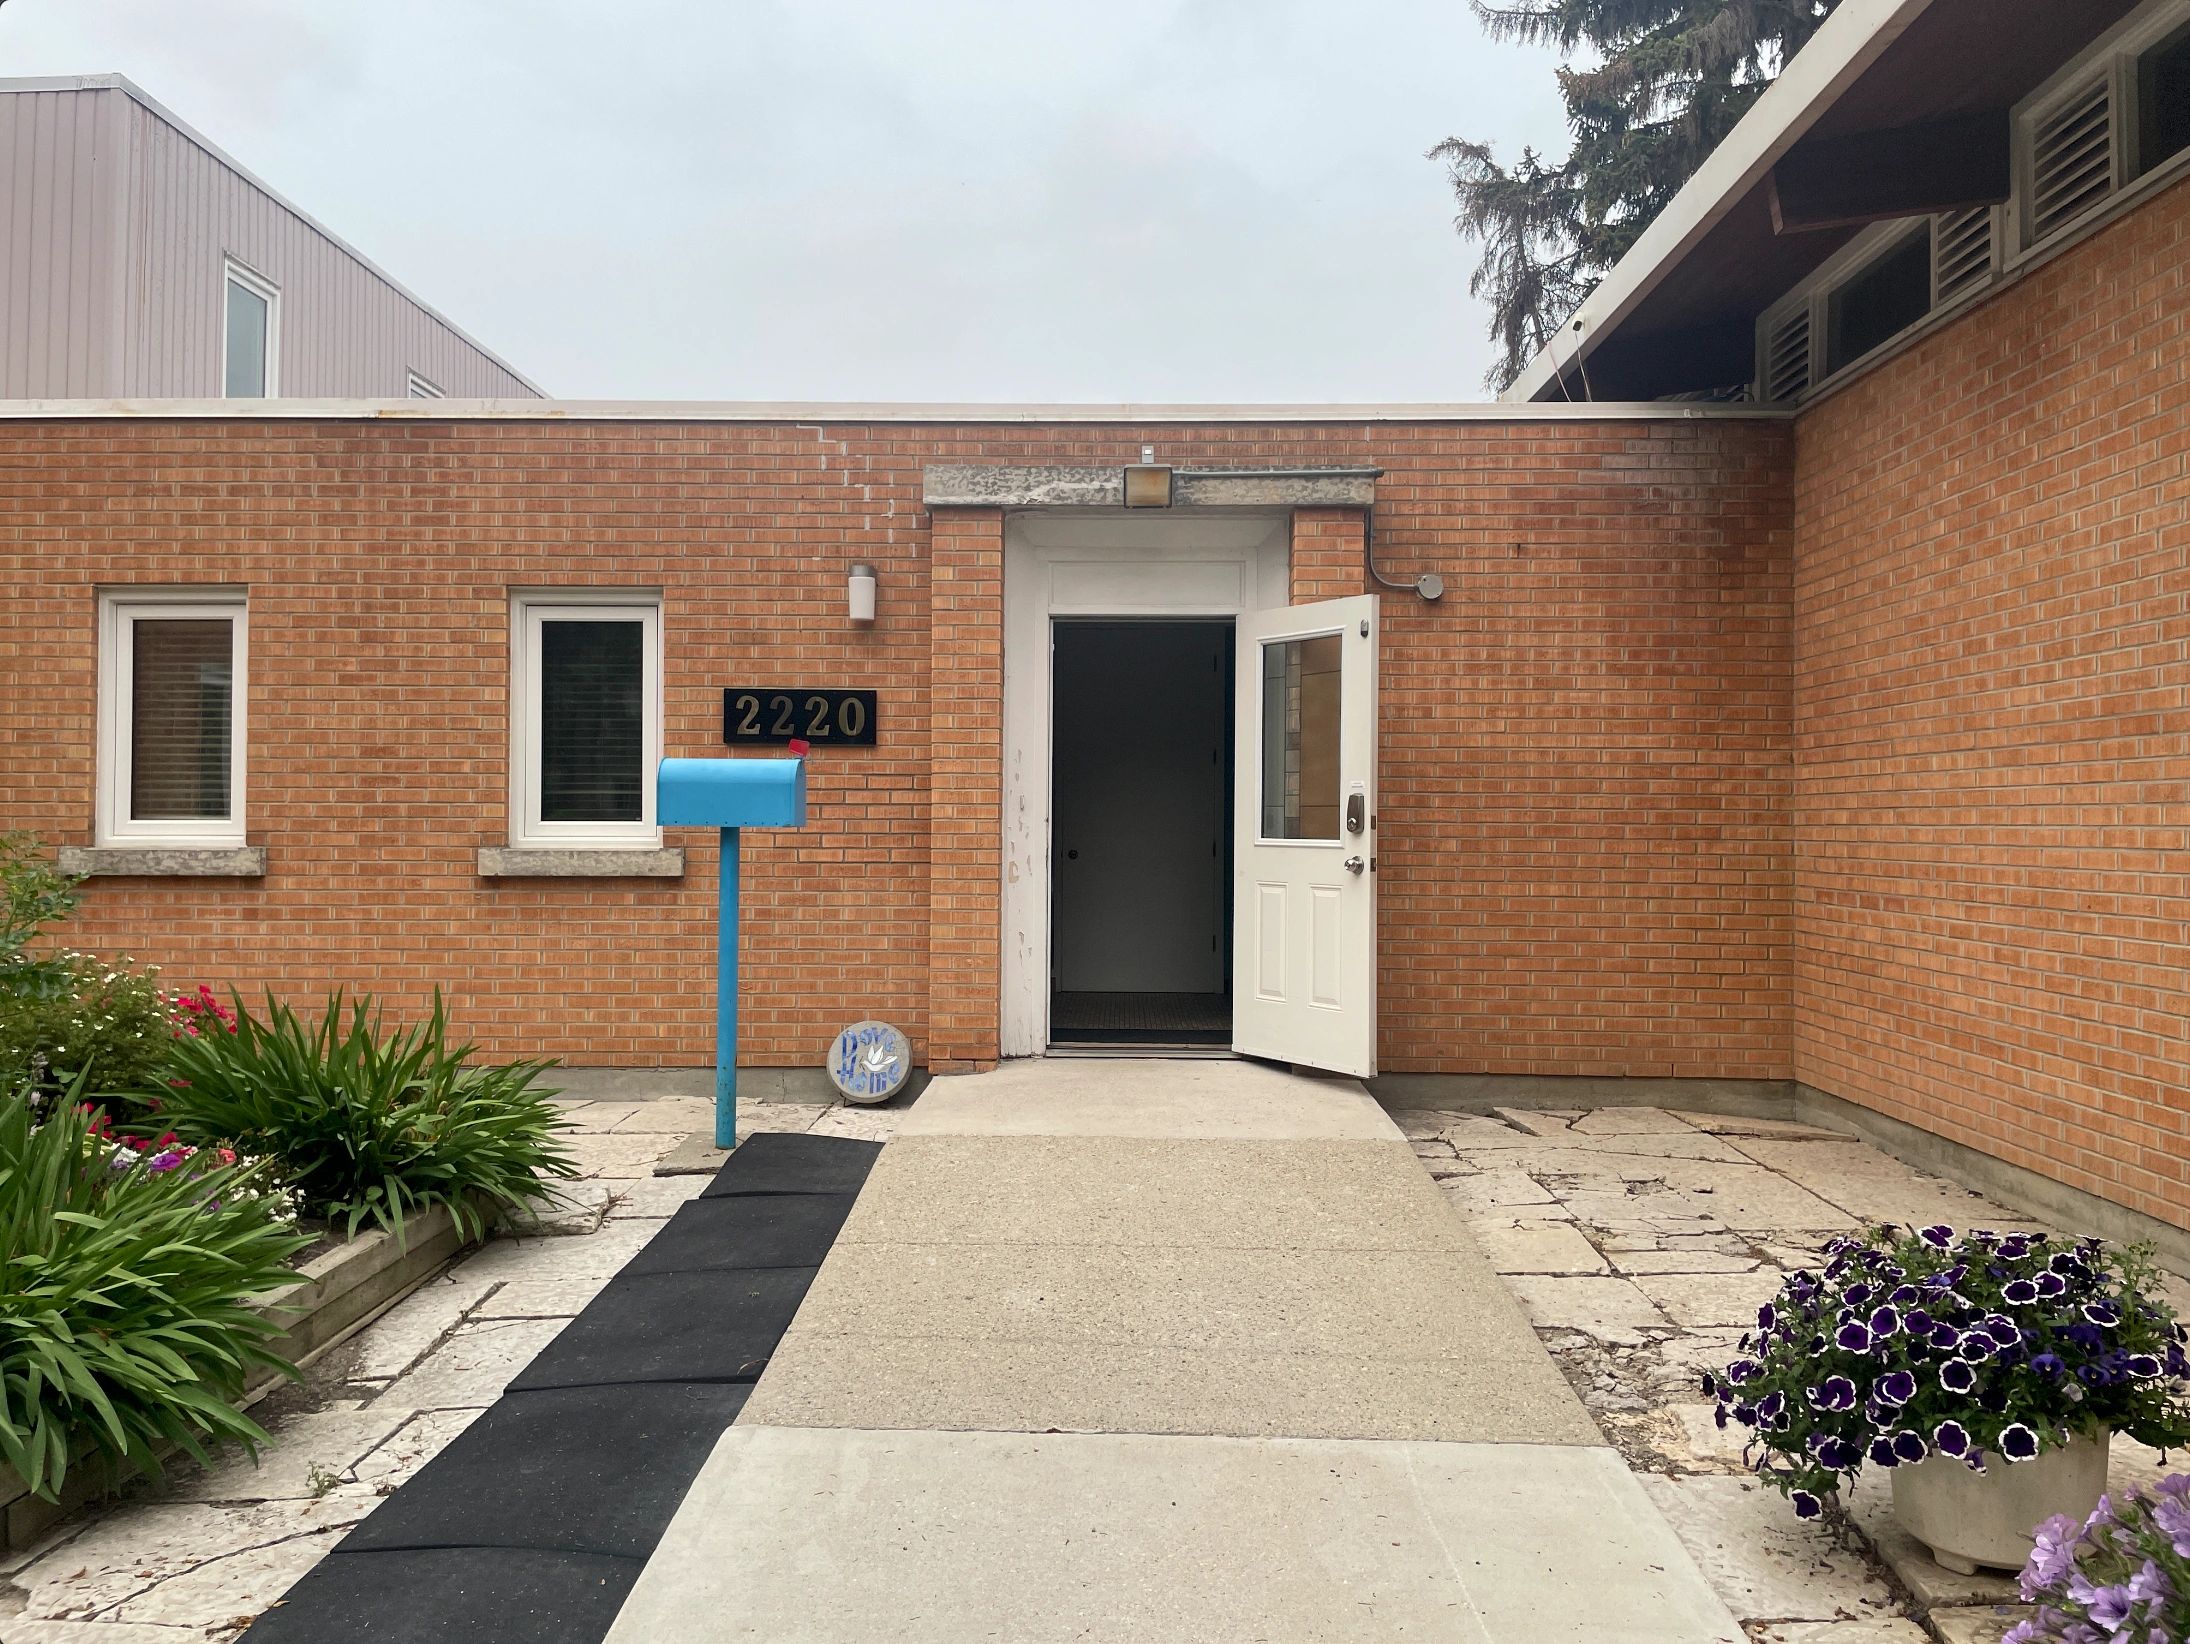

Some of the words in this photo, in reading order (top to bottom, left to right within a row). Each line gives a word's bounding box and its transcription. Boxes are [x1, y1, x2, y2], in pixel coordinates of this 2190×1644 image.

[735, 695, 865, 736] 2220
[841, 1027, 897, 1058] Dove
[836, 1056, 900, 1094] Home
